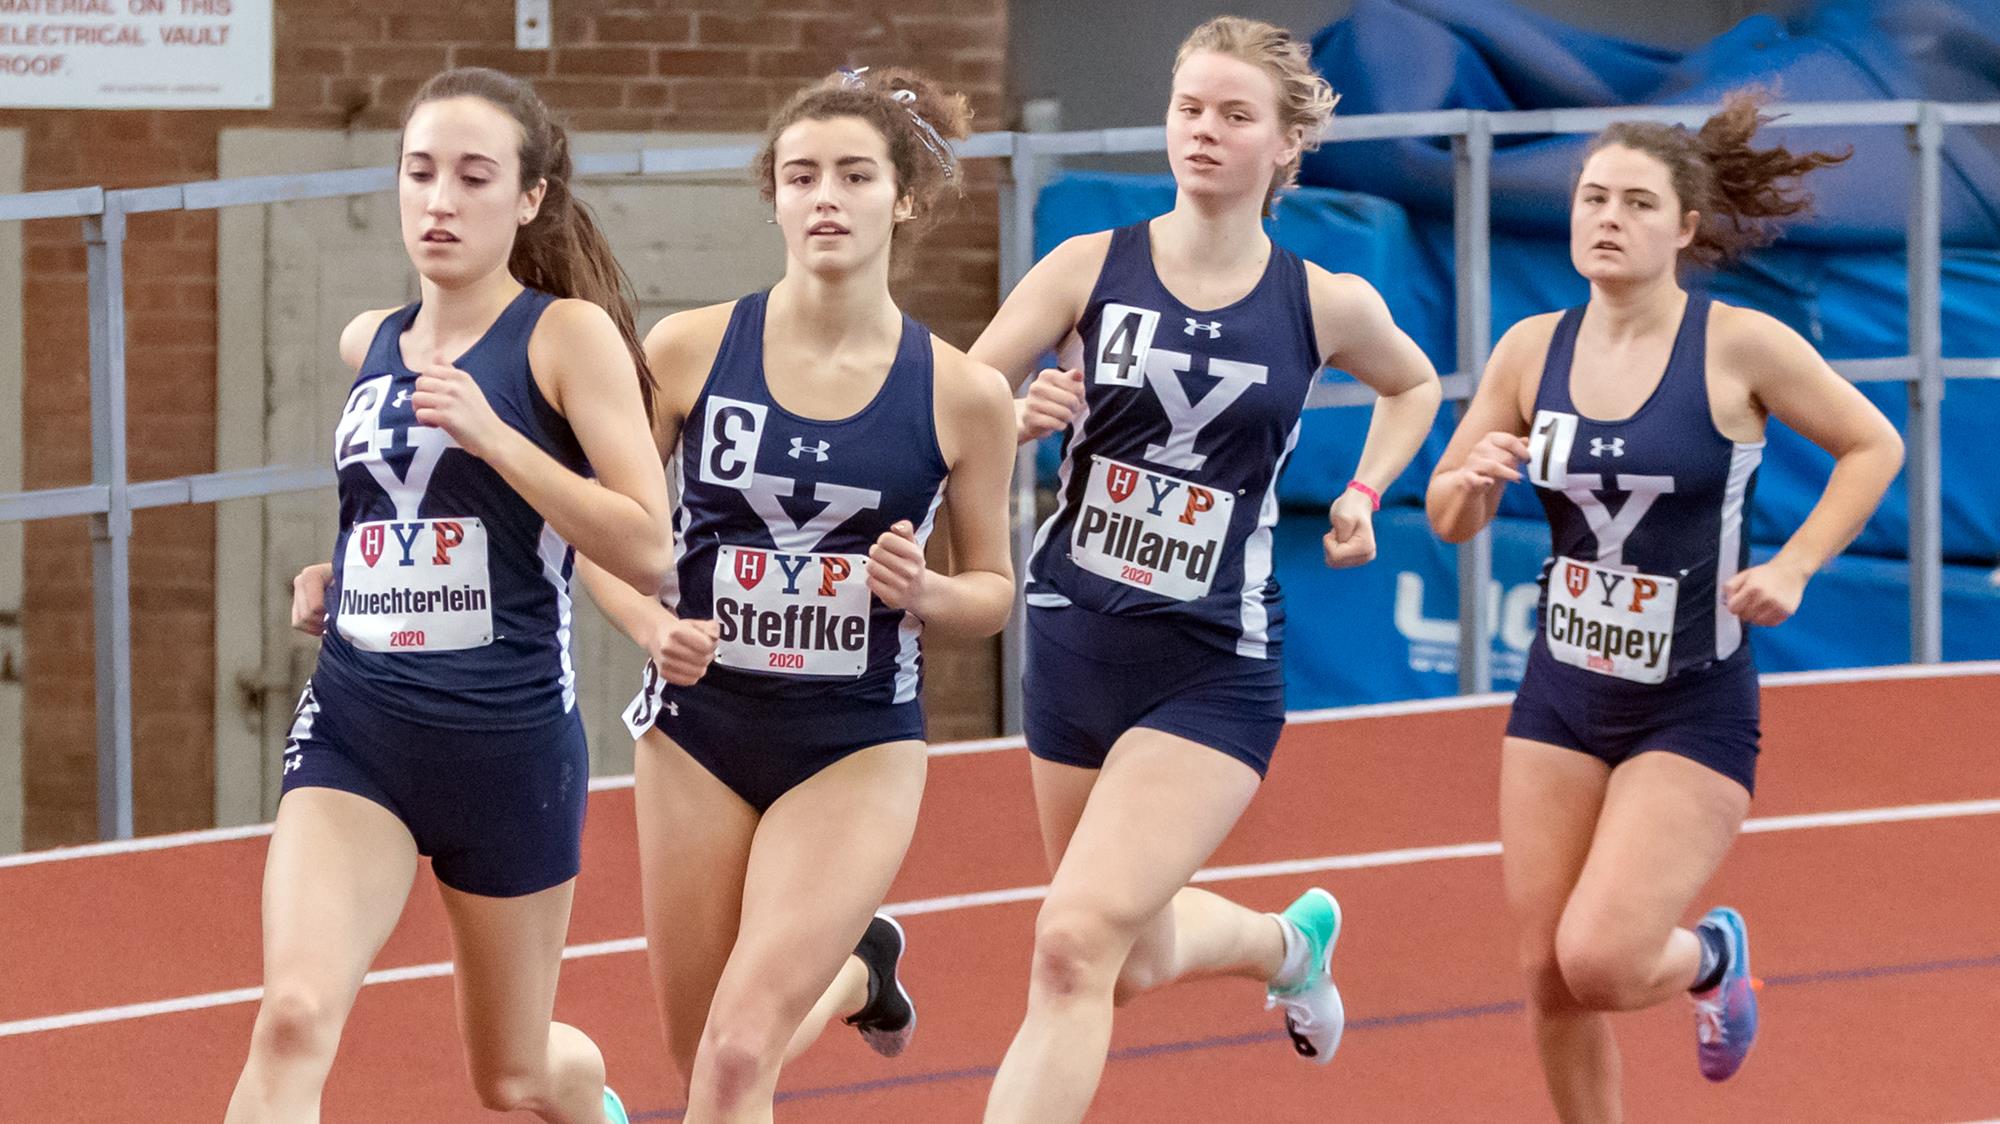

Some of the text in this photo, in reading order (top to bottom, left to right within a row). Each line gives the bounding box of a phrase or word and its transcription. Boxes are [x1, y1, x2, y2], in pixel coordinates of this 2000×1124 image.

[0, 0, 233, 16] MATERIAL ON THIS
[0, 24, 230, 46] ELECTRICAL VAULT
[1102, 312, 1142, 379] 4
[339, 386, 378, 461] 2
[1143, 348, 1269, 471] Y
[1538, 418, 1560, 481] 1
[1076, 506, 1217, 582] Pillard
[1563, 474, 1675, 573] Y
[341, 585, 488, 615] Nuechterlein
[1121, 565, 1153, 586] 2020
[390, 630, 425, 647] 2020
[716, 597, 865, 652] Steffke
[1551, 603, 1669, 668] Chapey
[769, 653, 804, 669] 2020
